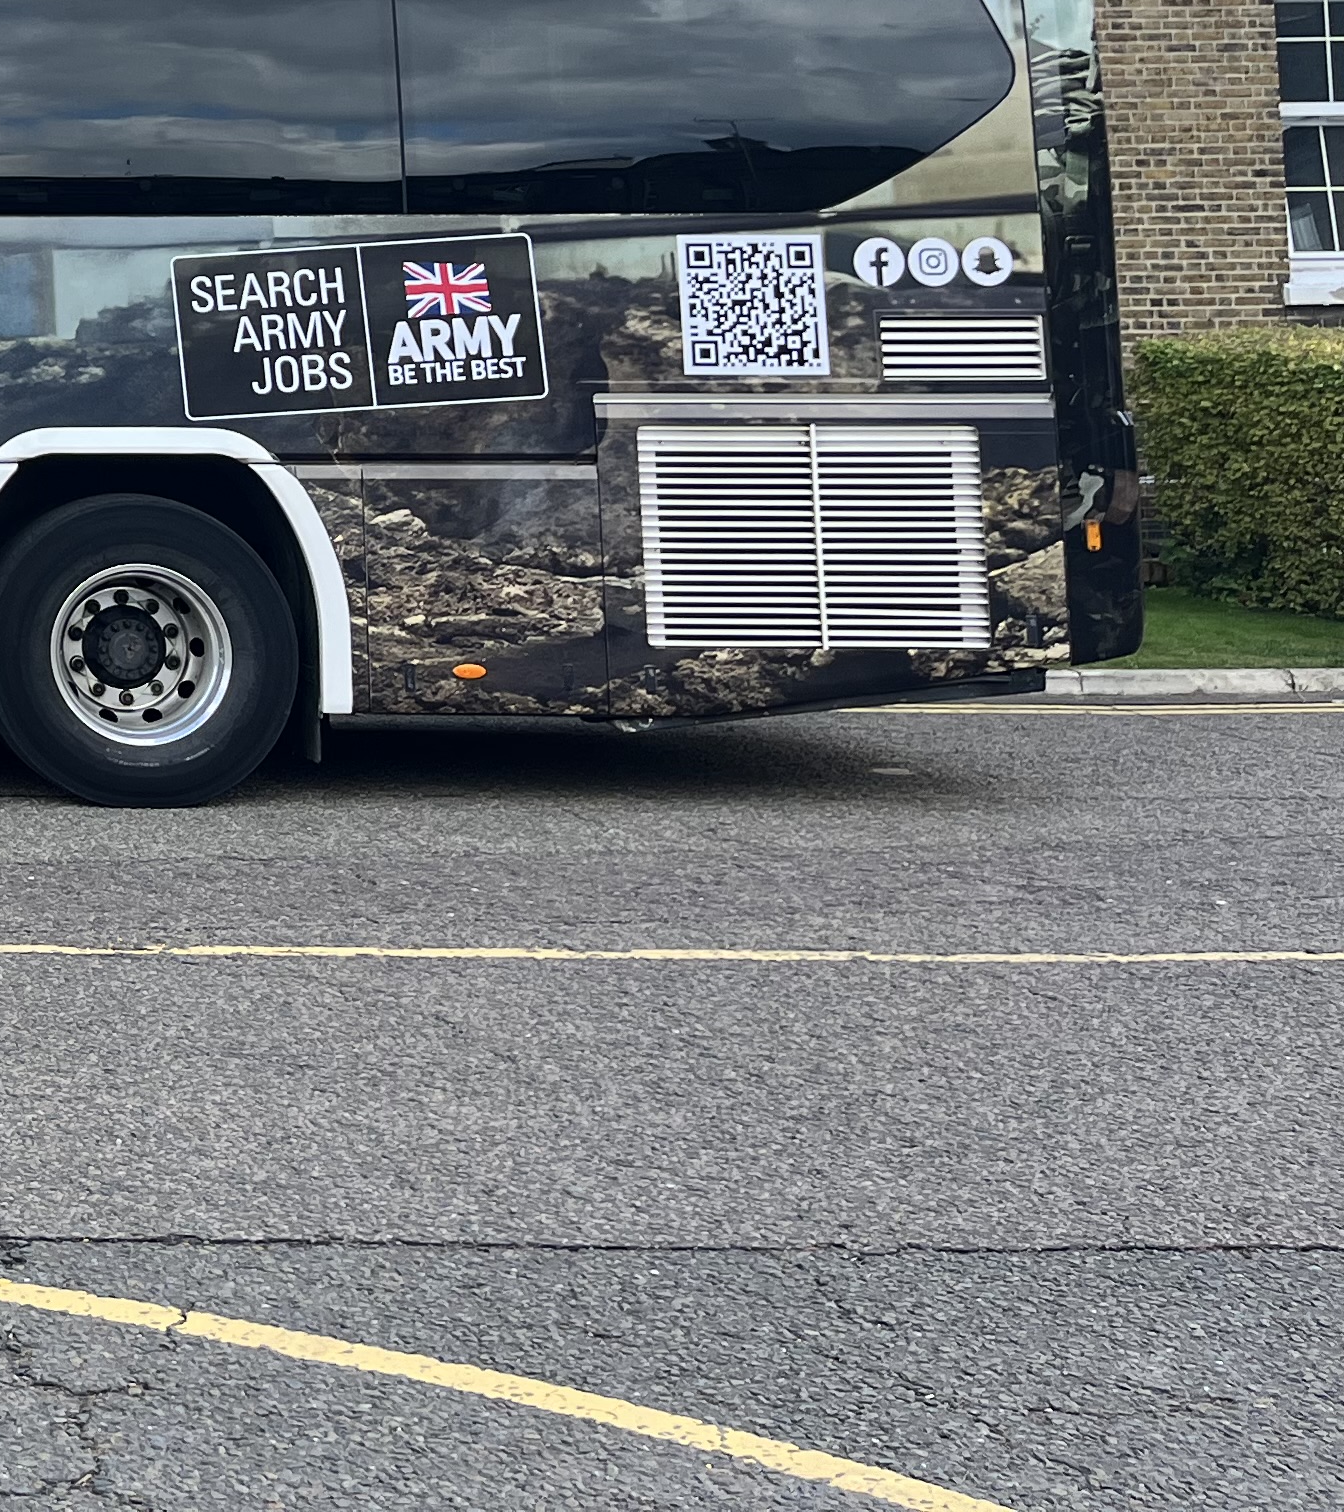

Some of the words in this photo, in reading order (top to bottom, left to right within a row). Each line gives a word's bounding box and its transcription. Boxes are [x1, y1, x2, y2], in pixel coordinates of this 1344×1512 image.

[190, 266, 345, 313] SEARCH
[233, 309, 347, 353] ARMY
[387, 313, 522, 365] ARMY
[251, 352, 353, 396] JOBS
[388, 363, 418, 386] BE
[419, 361, 467, 384] THE
[470, 357, 527, 381] BEST
